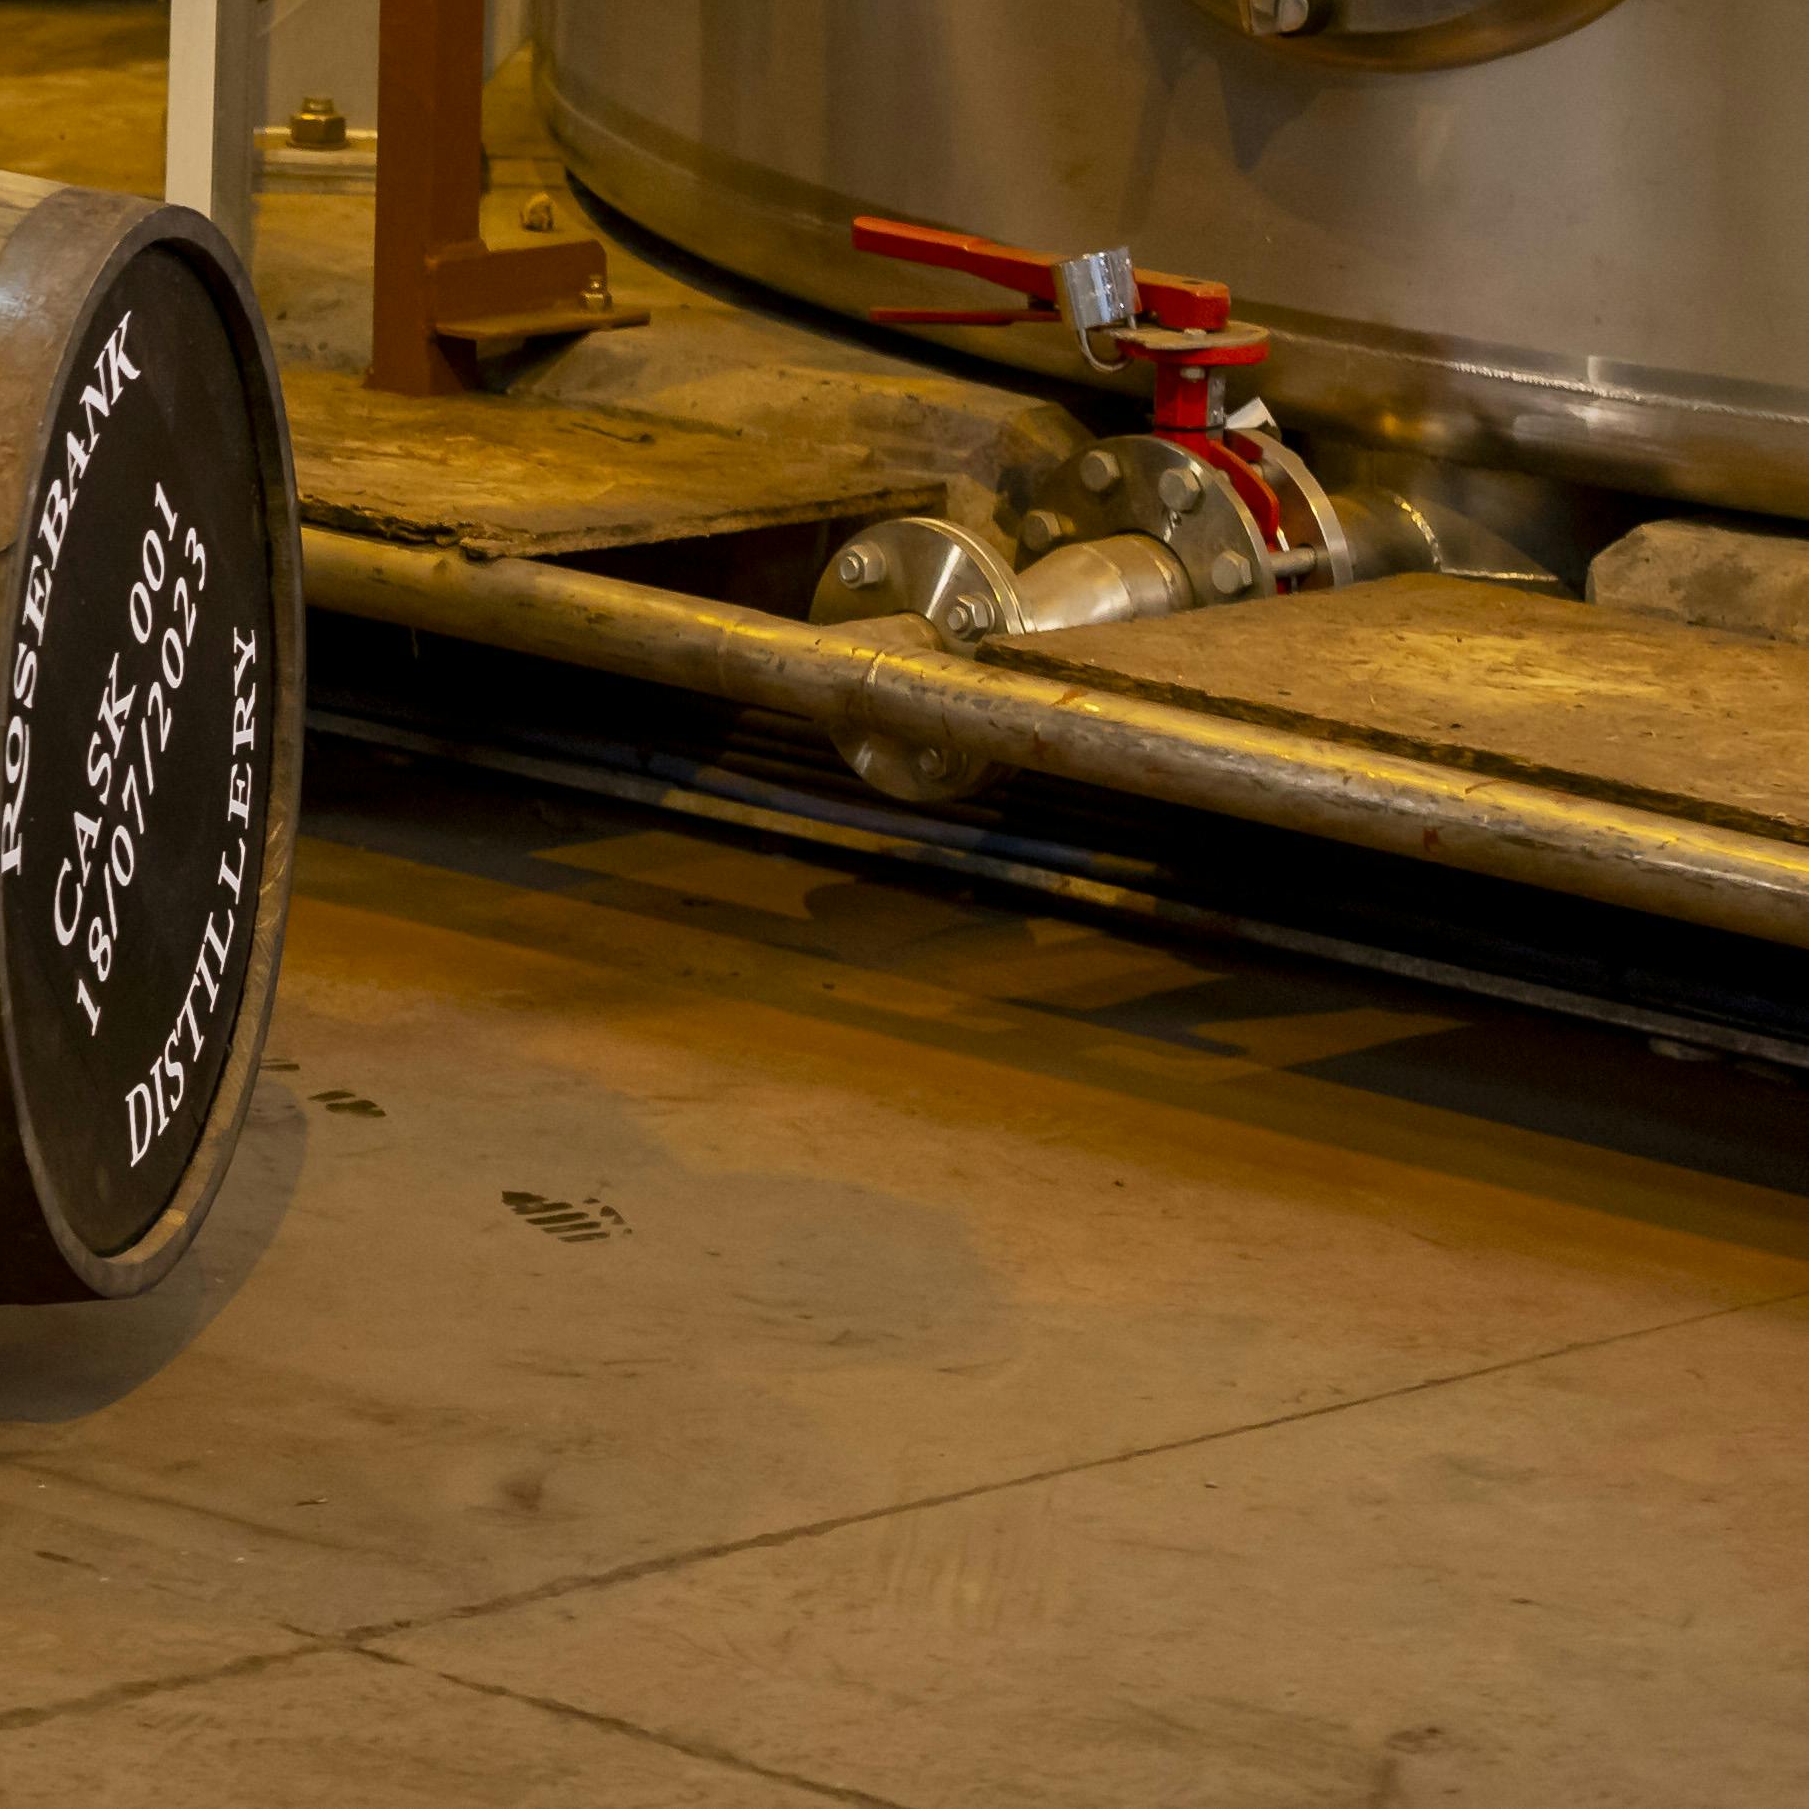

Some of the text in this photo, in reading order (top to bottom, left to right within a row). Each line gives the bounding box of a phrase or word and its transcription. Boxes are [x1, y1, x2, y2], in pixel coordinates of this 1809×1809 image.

[2, 310, 142, 876] ROSEBANK
[53, 481, 180, 948] CASK 001
[75, 526, 208, 1037] 18/07/2023
[125, 627, 257, 1170] DISTILLERY
